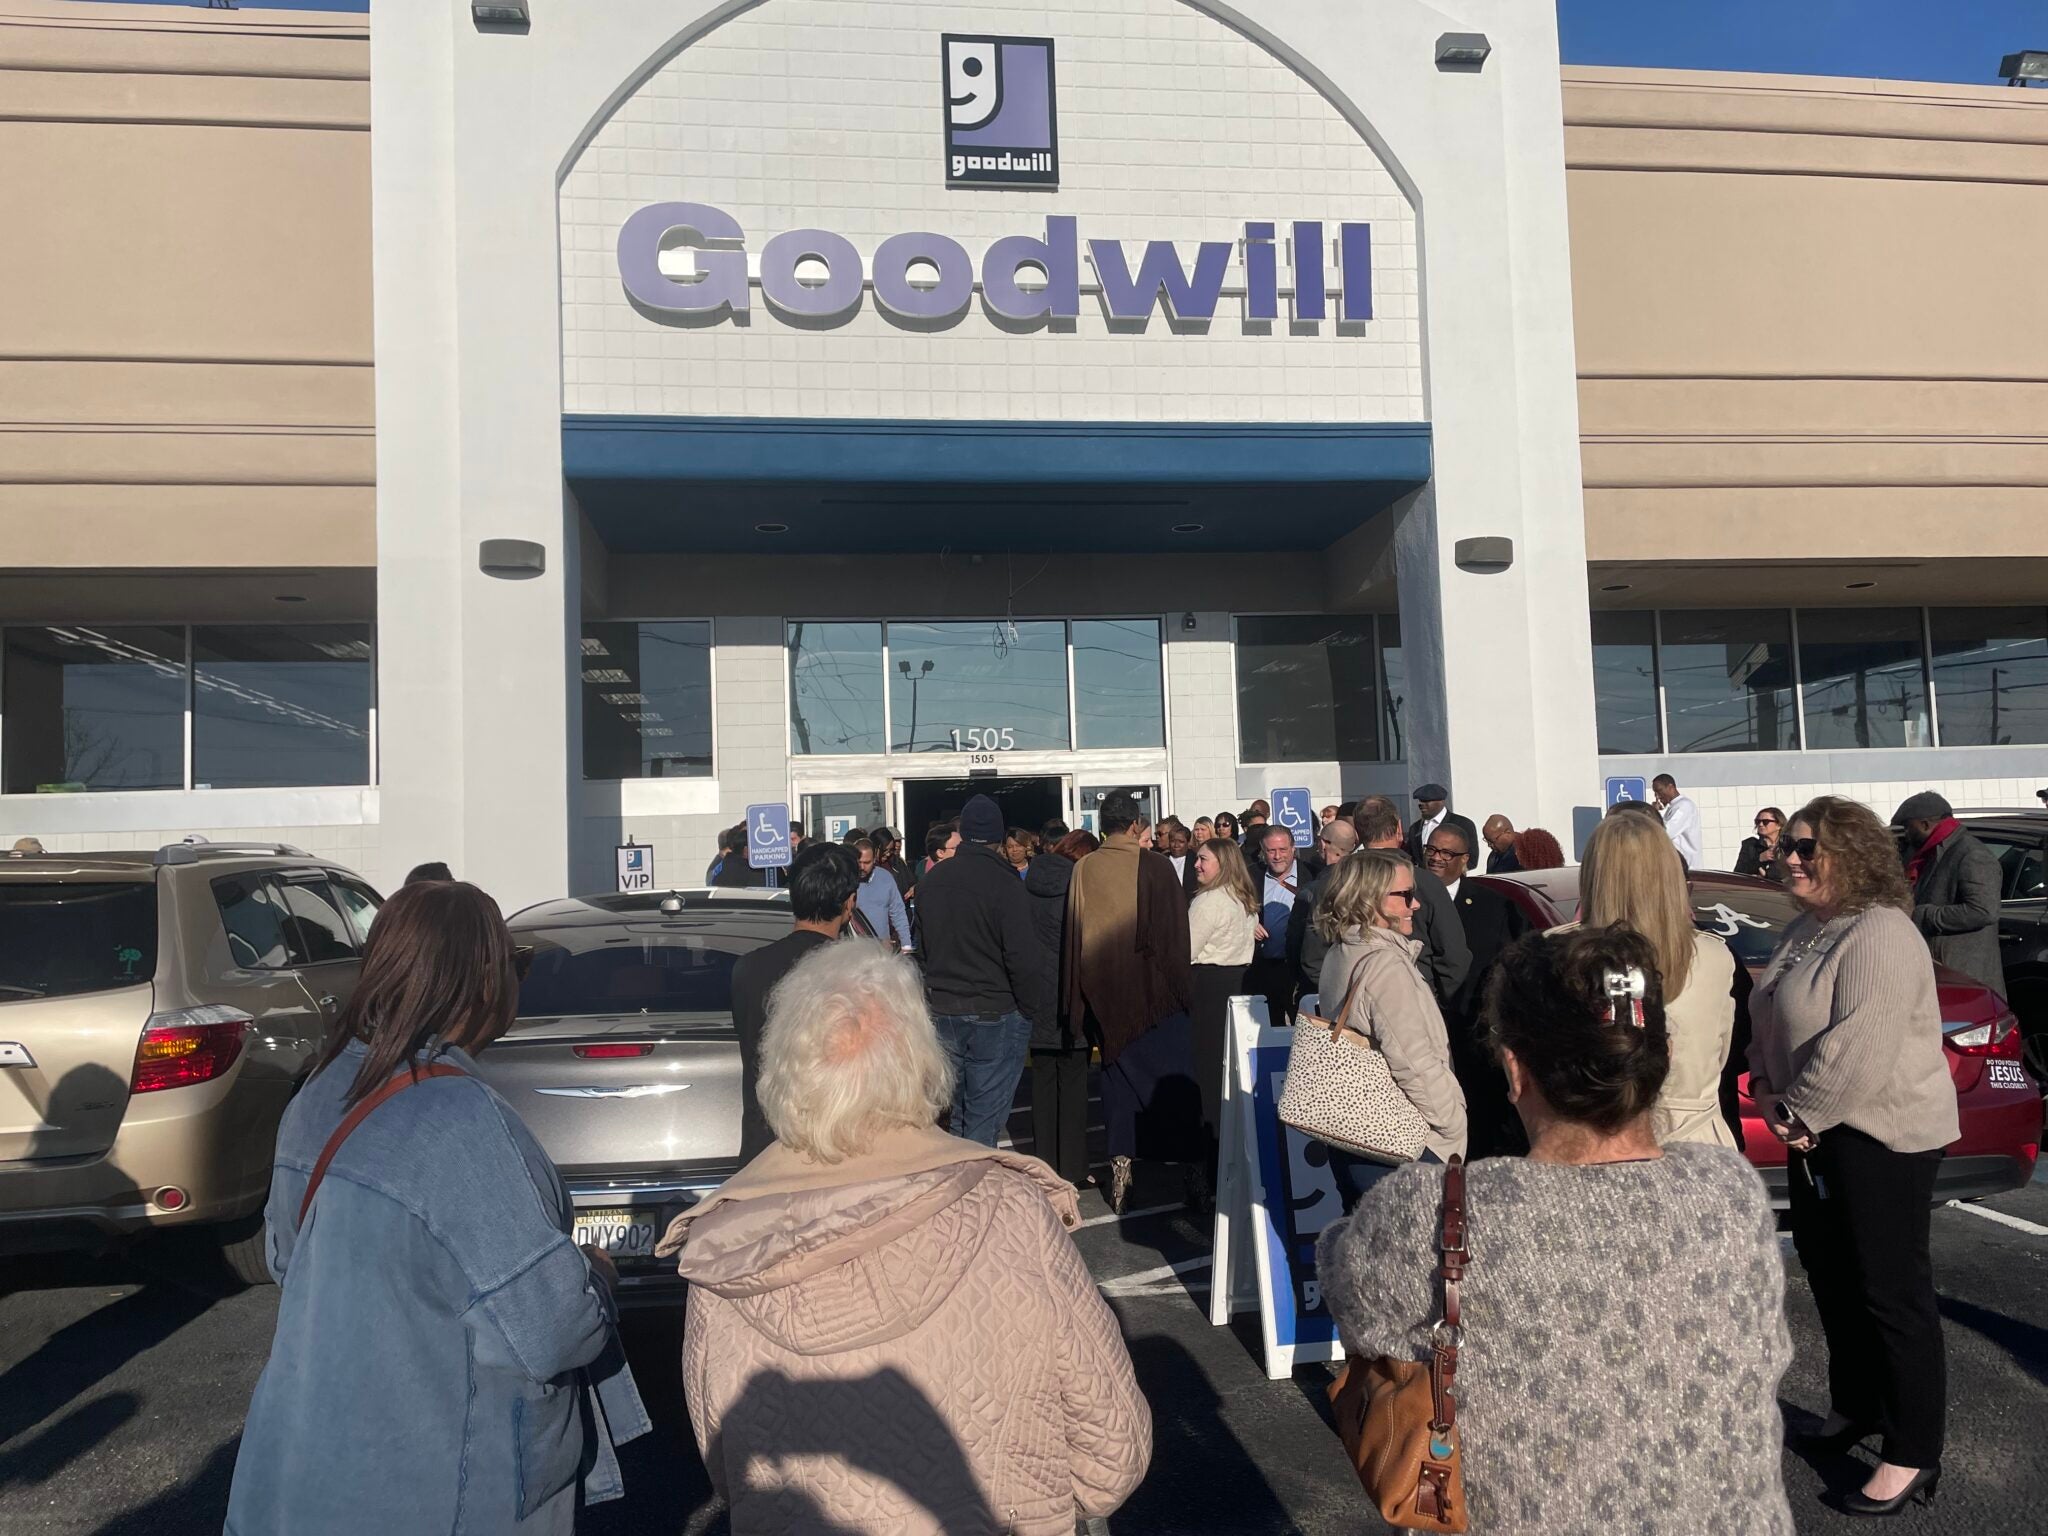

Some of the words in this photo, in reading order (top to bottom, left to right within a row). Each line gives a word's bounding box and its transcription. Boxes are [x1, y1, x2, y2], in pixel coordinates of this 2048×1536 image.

[952, 152, 1052, 177] goodwill
[616, 201, 1373, 324] Goodwill
[951, 728, 1014, 751] 1505
[971, 755, 995, 764] 1505
[752, 846, 788, 854] HANDICAPPED
[754, 853, 786, 861] PARKING
[621, 874, 650, 889] VIP
[1989, 1066, 2024, 1082] JESUS
[576, 1215, 634, 1225] GEORGIA
